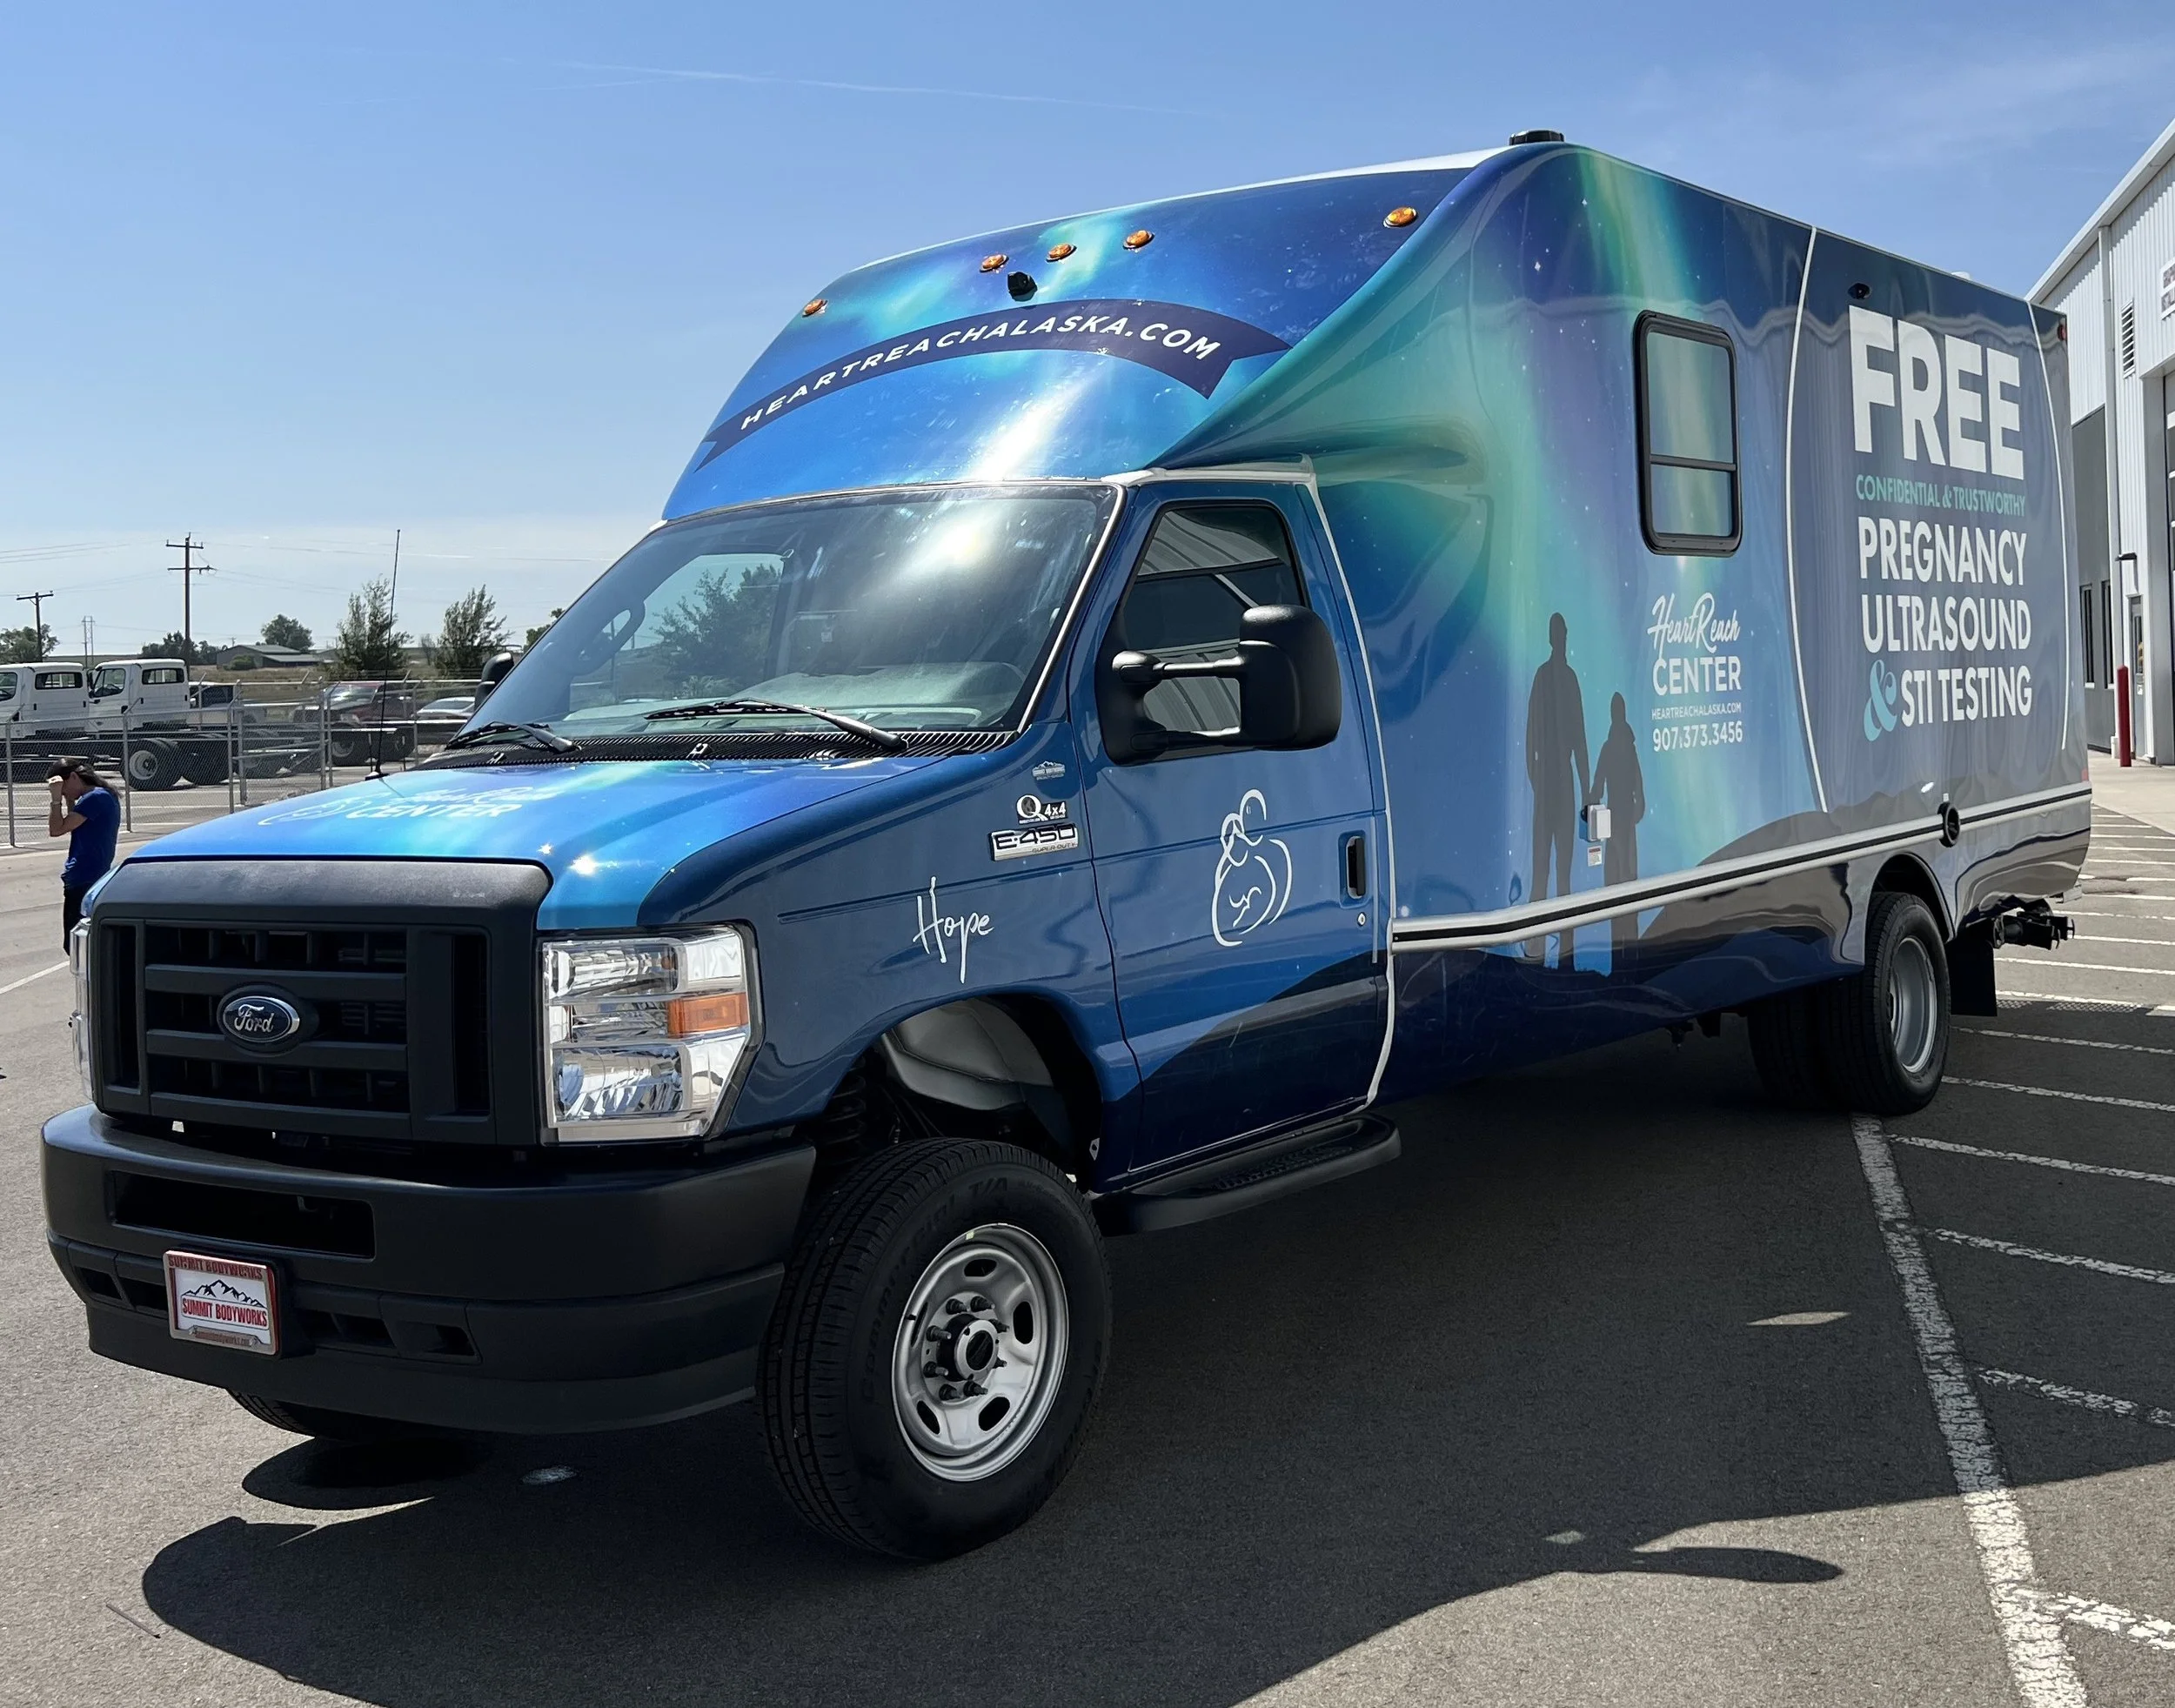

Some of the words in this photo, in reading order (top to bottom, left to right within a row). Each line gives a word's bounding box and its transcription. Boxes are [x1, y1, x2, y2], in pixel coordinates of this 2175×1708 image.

[740, 314, 1221, 431] HEARTREACHALASKA.COM
[1849, 305, 2024, 480] FREE
[1856, 475, 1940, 508] CONFIDENTIAL
[1943, 485, 1952, 508] &
[1953, 486, 2025, 516] TRUSTWORTHY
[1858, 517, 2027, 586] PREGNANCY
[1862, 594, 2031, 653] ULTRASOUND
[1652, 656, 1742, 696] CENTER
[1651, 703, 1742, 720] HEARTREACHALASKA.COM
[1864, 660, 1897, 741] &
[1901, 669, 1933, 727] STI
[1938, 666, 2032, 721] TESTING
[1653, 721, 1743, 752] 907.373.3456
[346, 803, 522, 820] CENTER
[1045, 801, 1067, 816] 4x4
[913, 876, 994, 983] Hope
[234, 1003, 275, 1033] Ford
[182, 1297, 213, 1318] SUMMIT
[216, 1303, 267, 1327] BODYWORKS
